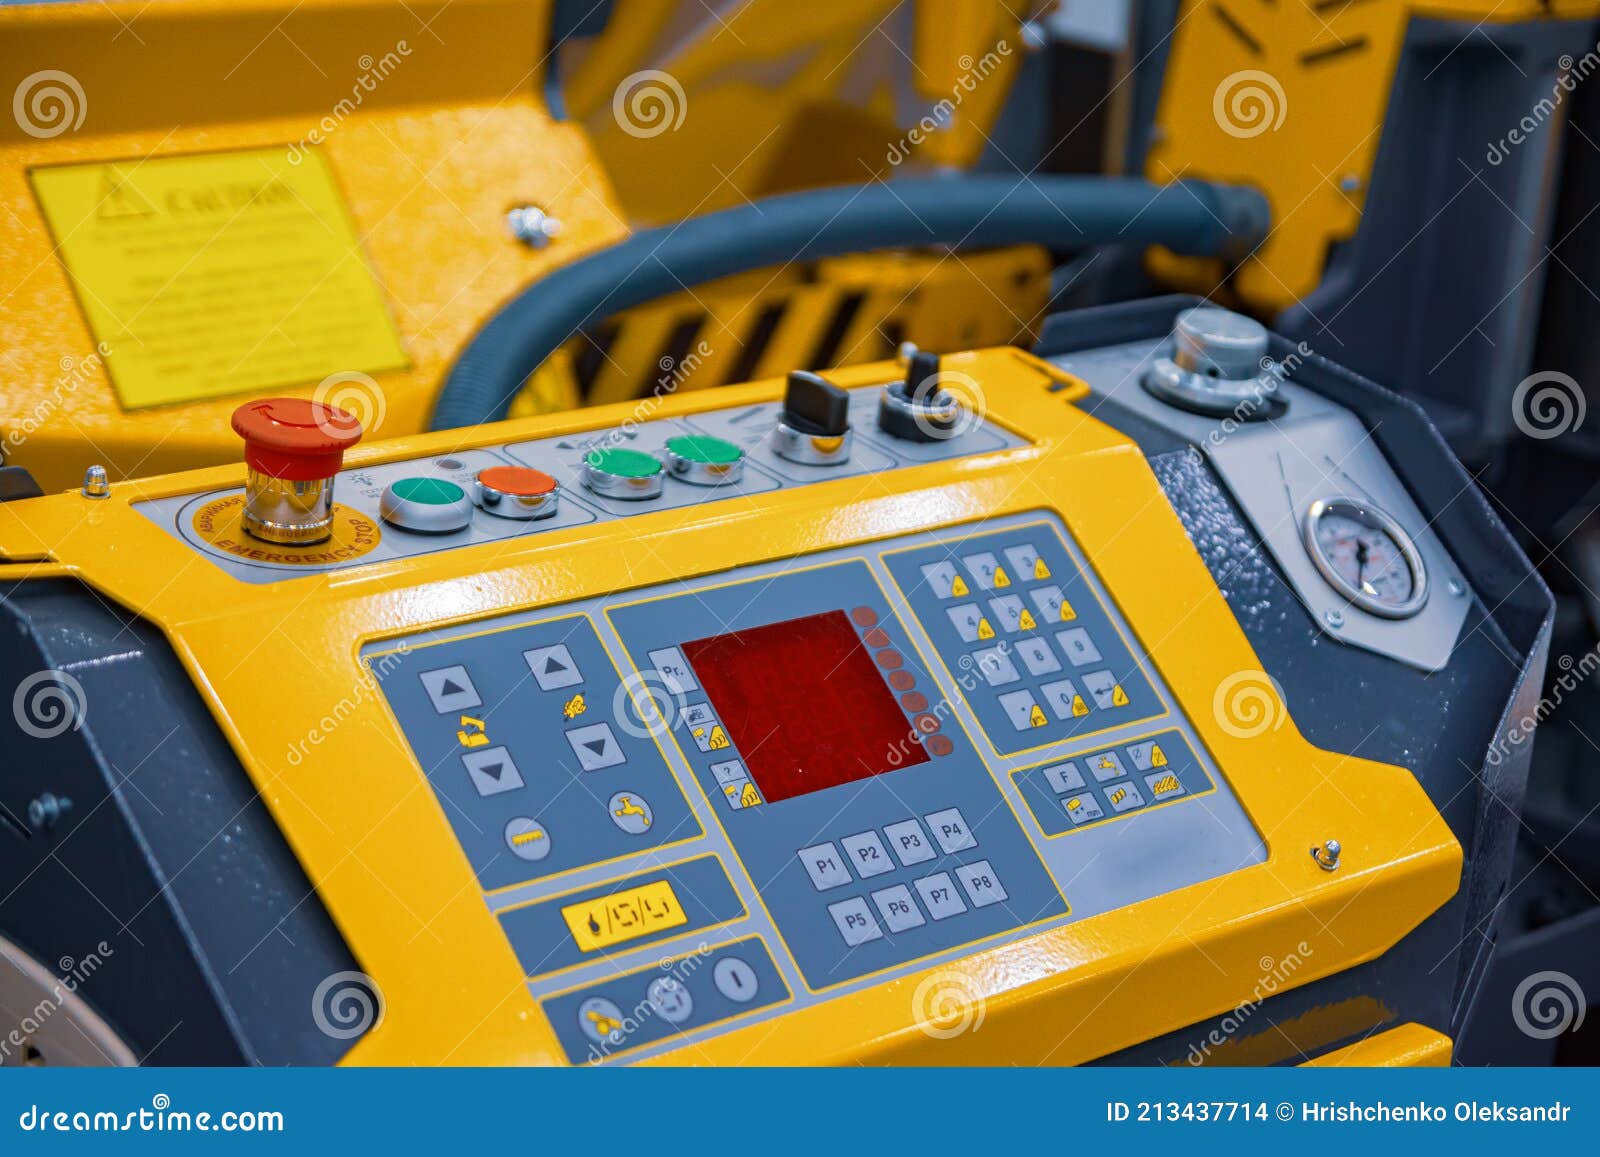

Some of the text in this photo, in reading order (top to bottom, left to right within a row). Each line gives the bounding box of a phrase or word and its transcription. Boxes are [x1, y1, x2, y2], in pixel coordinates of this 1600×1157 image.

[215, 518, 373, 563] EMERGENCY STOP
[981, 564, 993, 577] 2
[1022, 556, 1033, 568] 3
[967, 598, 1059, 628] 4 5 6
[1033, 649, 1044, 662] 8
[1074, 640, 1085, 652] 9
[662, 665, 685, 678] Pr.
[1060, 771, 1070, 784] F
[816, 823, 962, 874] P1 P2 P3 P4
[845, 875, 992, 929] P5 P6 P7 P8
